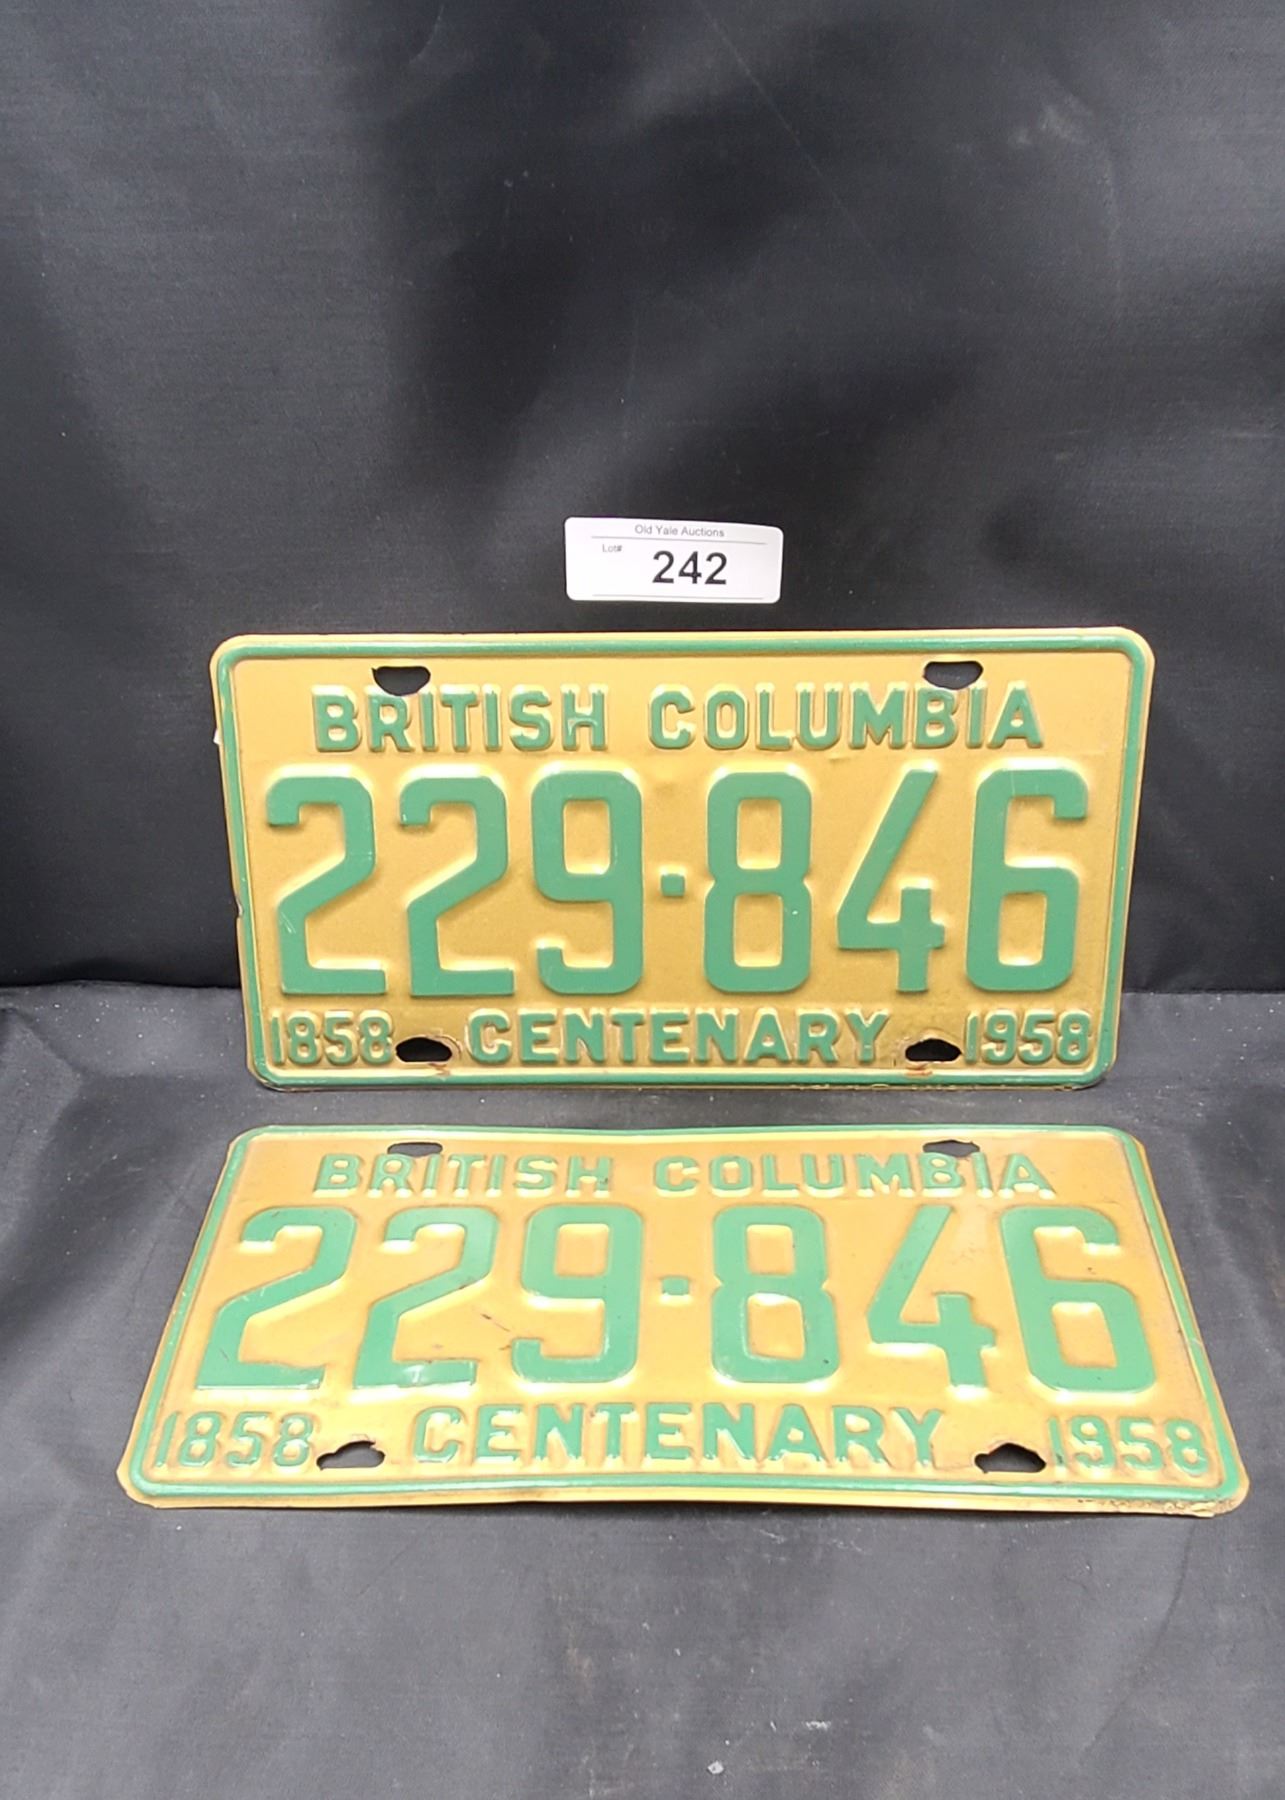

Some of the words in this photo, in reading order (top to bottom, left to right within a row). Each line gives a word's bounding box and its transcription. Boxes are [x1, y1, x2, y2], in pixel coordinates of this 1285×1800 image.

[602, 544, 623, 553] Lot#
[634, 524, 653, 535] Old
[655, 525, 679, 537] Yale
[681, 526, 725, 538] Auctions
[652, 550, 728, 585] 242
[312, 685, 608, 752] BRITISH
[648, 681, 1044, 750] COLUMBIA
[270, 1010, 393, 1066] 1858
[467, 1009, 891, 1065] CENTENARY
[964, 1010, 1092, 1064] 1958
[313, 1153, 615, 1196] BRITISH
[653, 1151, 1057, 1198] COLUMBIA
[153, 1409, 316, 1470] 1858
[412, 1401, 945, 1468] CENTENARY
[1047, 1413, 1209, 1476] 1958
